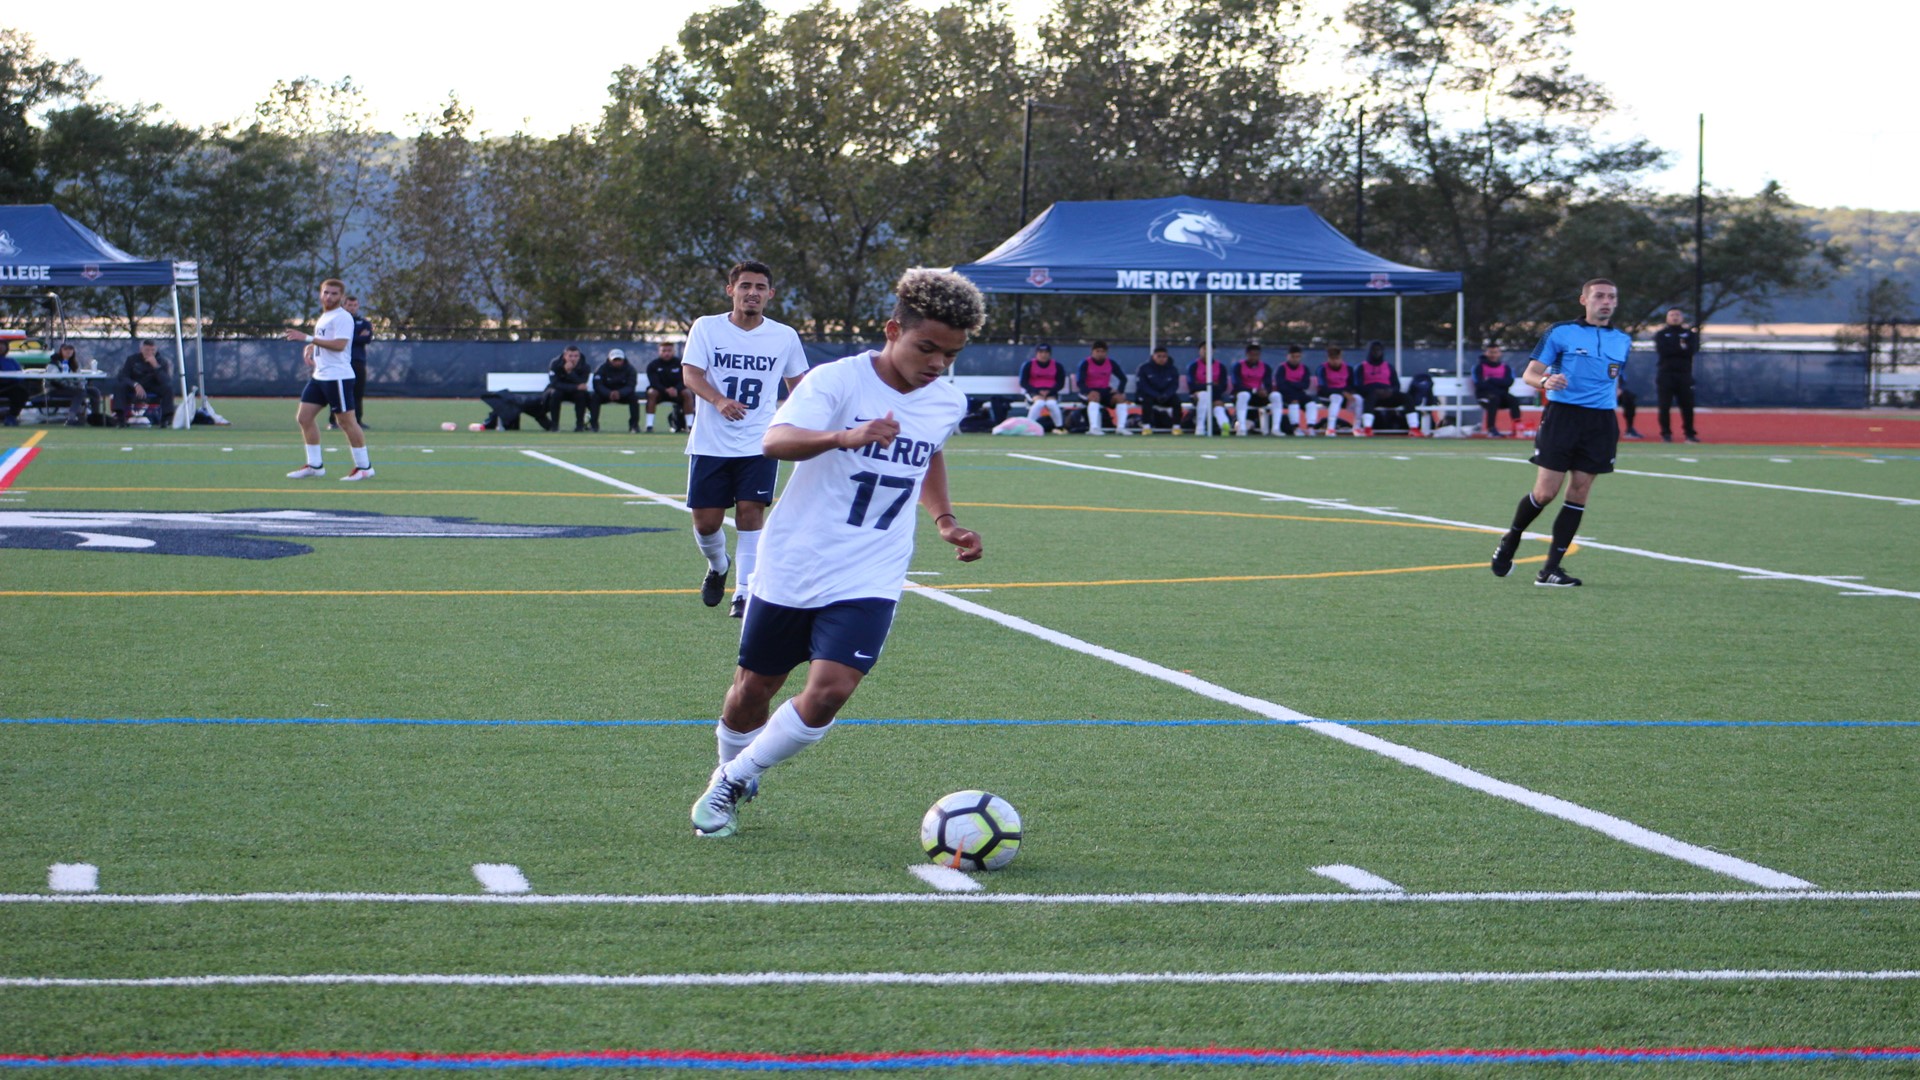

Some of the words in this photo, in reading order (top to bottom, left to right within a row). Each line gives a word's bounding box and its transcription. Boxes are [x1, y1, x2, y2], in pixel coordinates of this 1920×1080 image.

[1116, 270, 1200, 290] MERCY
[1206, 272, 1303, 291] COLLEGE
[713, 352, 778, 371] MERCY
[722, 375, 763, 410] 18
[846, 470, 916, 531] 17
